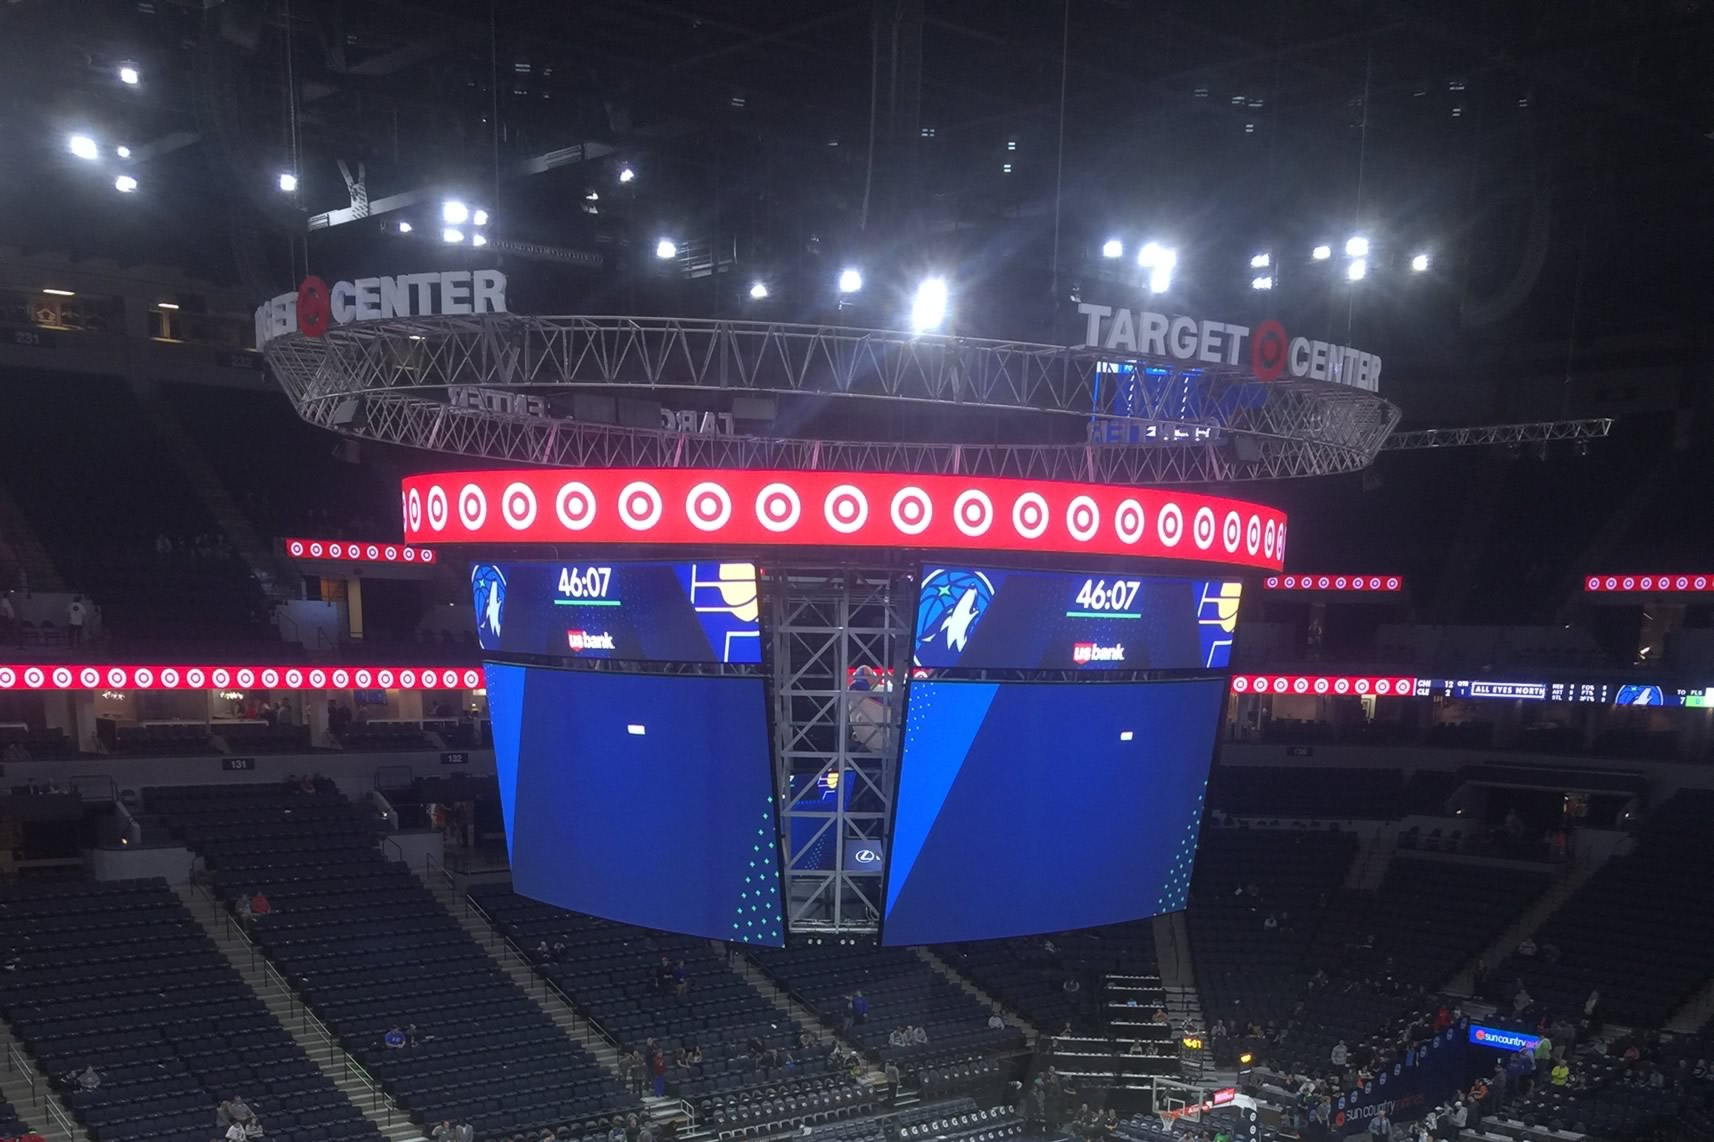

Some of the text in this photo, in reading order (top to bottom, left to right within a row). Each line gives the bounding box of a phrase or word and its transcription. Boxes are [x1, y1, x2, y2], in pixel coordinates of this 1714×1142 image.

[331, 269, 508, 324] CENTER
[1078, 303, 1383, 392] TARGET CENTER
[558, 566, 612, 598] 46:07
[1075, 579, 1141, 610] 46:07
[1417, 680, 1431, 688] CHI
[1445, 680, 1454, 688] 12
[1416, 688, 1430, 696] CLE
[1445, 689, 1451, 697] 2
[1475, 685, 1545, 695] ALL EYES NORTH
[448, 754, 462, 763] 132
[231, 760, 246, 769] 131
